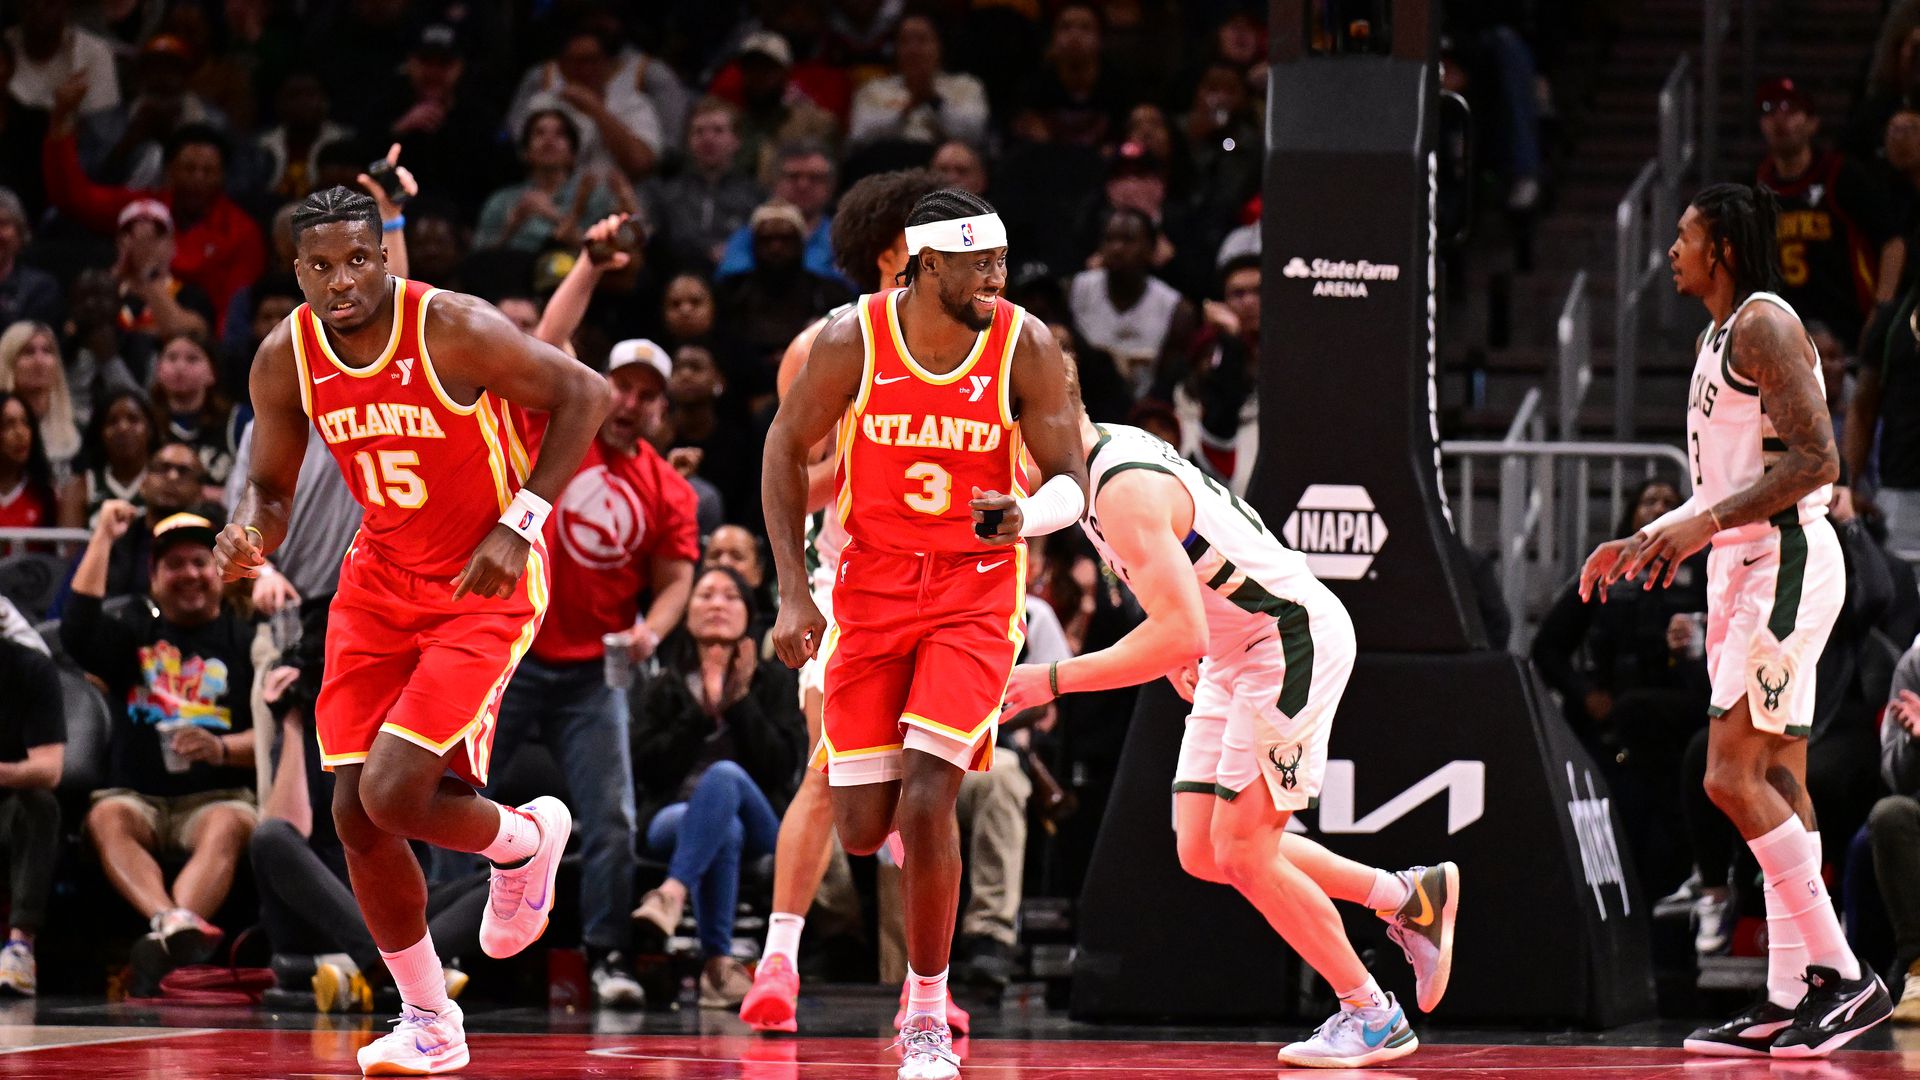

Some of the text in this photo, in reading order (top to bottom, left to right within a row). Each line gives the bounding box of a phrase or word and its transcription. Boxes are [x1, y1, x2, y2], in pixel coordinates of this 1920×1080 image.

[1312, 280, 1369, 299] ARENA
[317, 402, 447, 445] ATLANTA
[862, 413, 1001, 453] ATLANTA
[353, 449, 429, 509] 15
[903, 461, 952, 516] 3
[1300, 510, 1372, 553] NAPA
